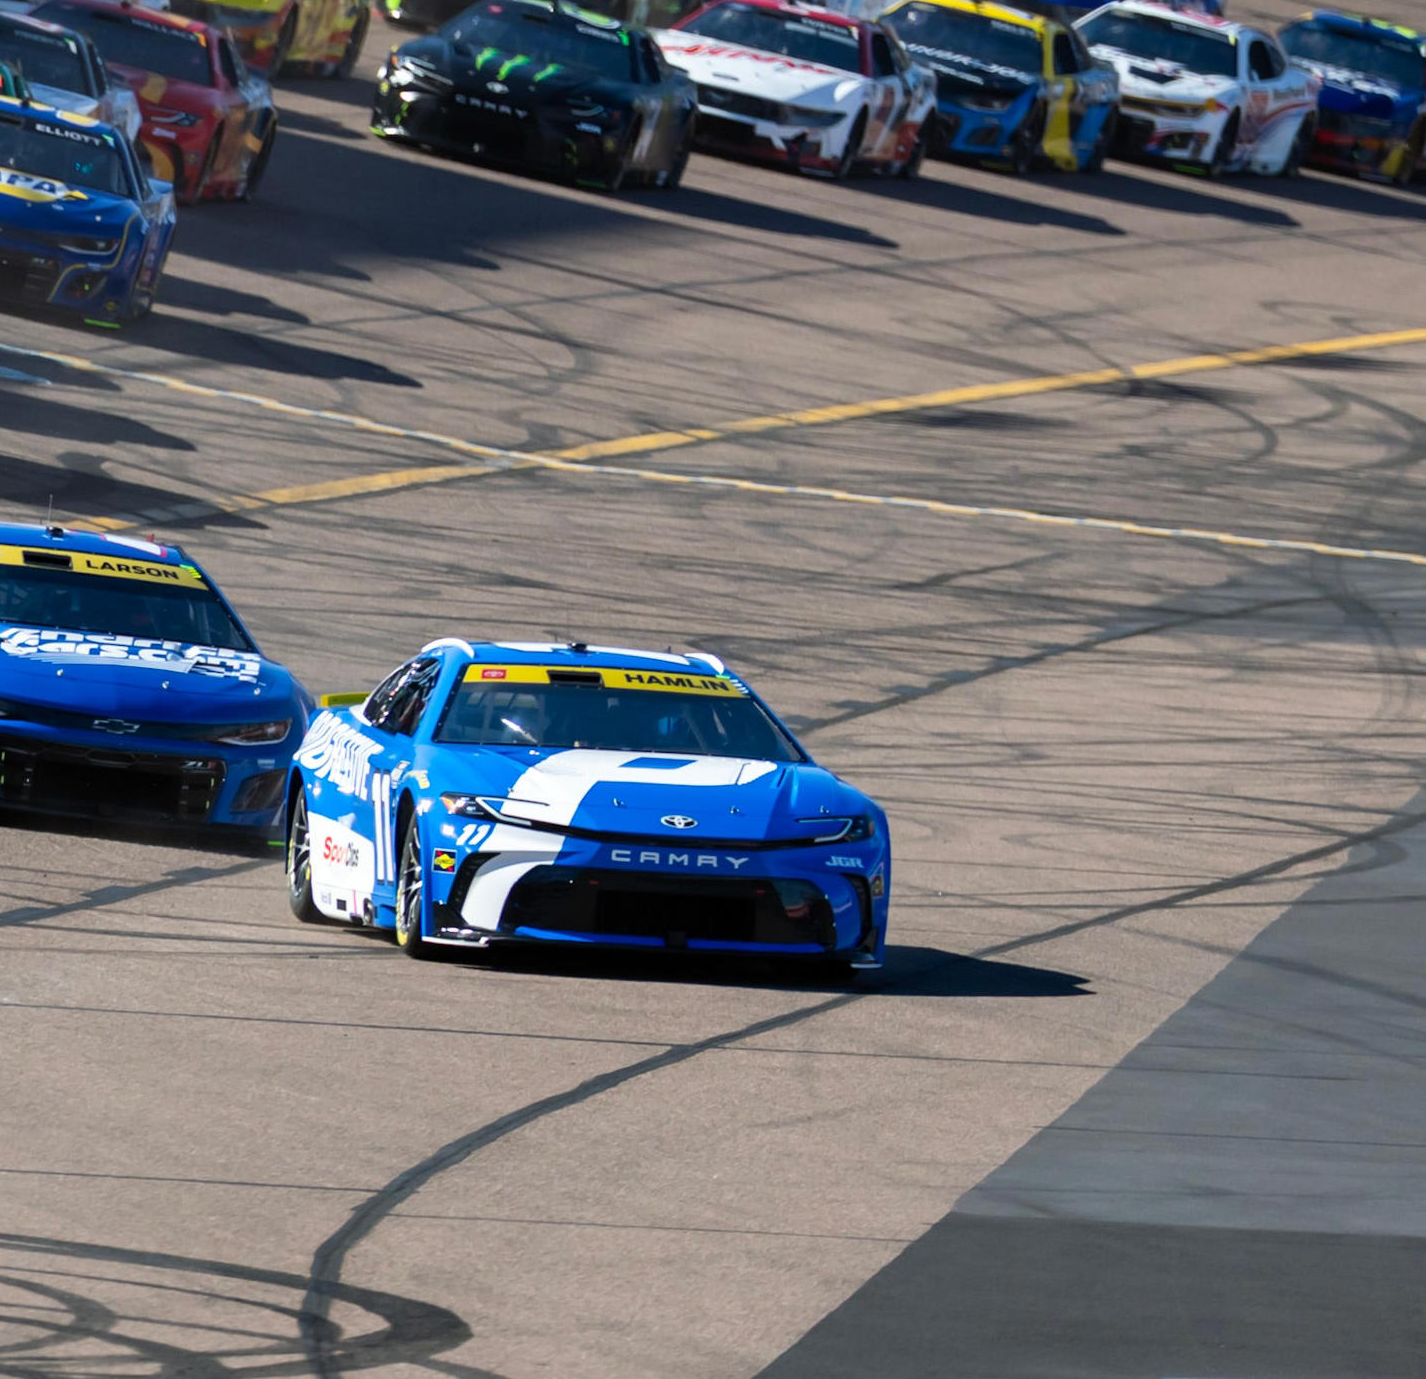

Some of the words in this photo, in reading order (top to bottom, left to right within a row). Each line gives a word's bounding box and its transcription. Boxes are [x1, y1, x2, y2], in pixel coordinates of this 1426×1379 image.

[35, 123, 101, 146] ELLIOTT
[86, 559, 179, 581] LARSON
[625, 672, 728, 692] HAMLIN
[372, 771, 394, 882] 11
[456, 824, 490, 845] 11
[611, 849, 749, 869] CAMRY
[826, 855, 863, 868] JGR
